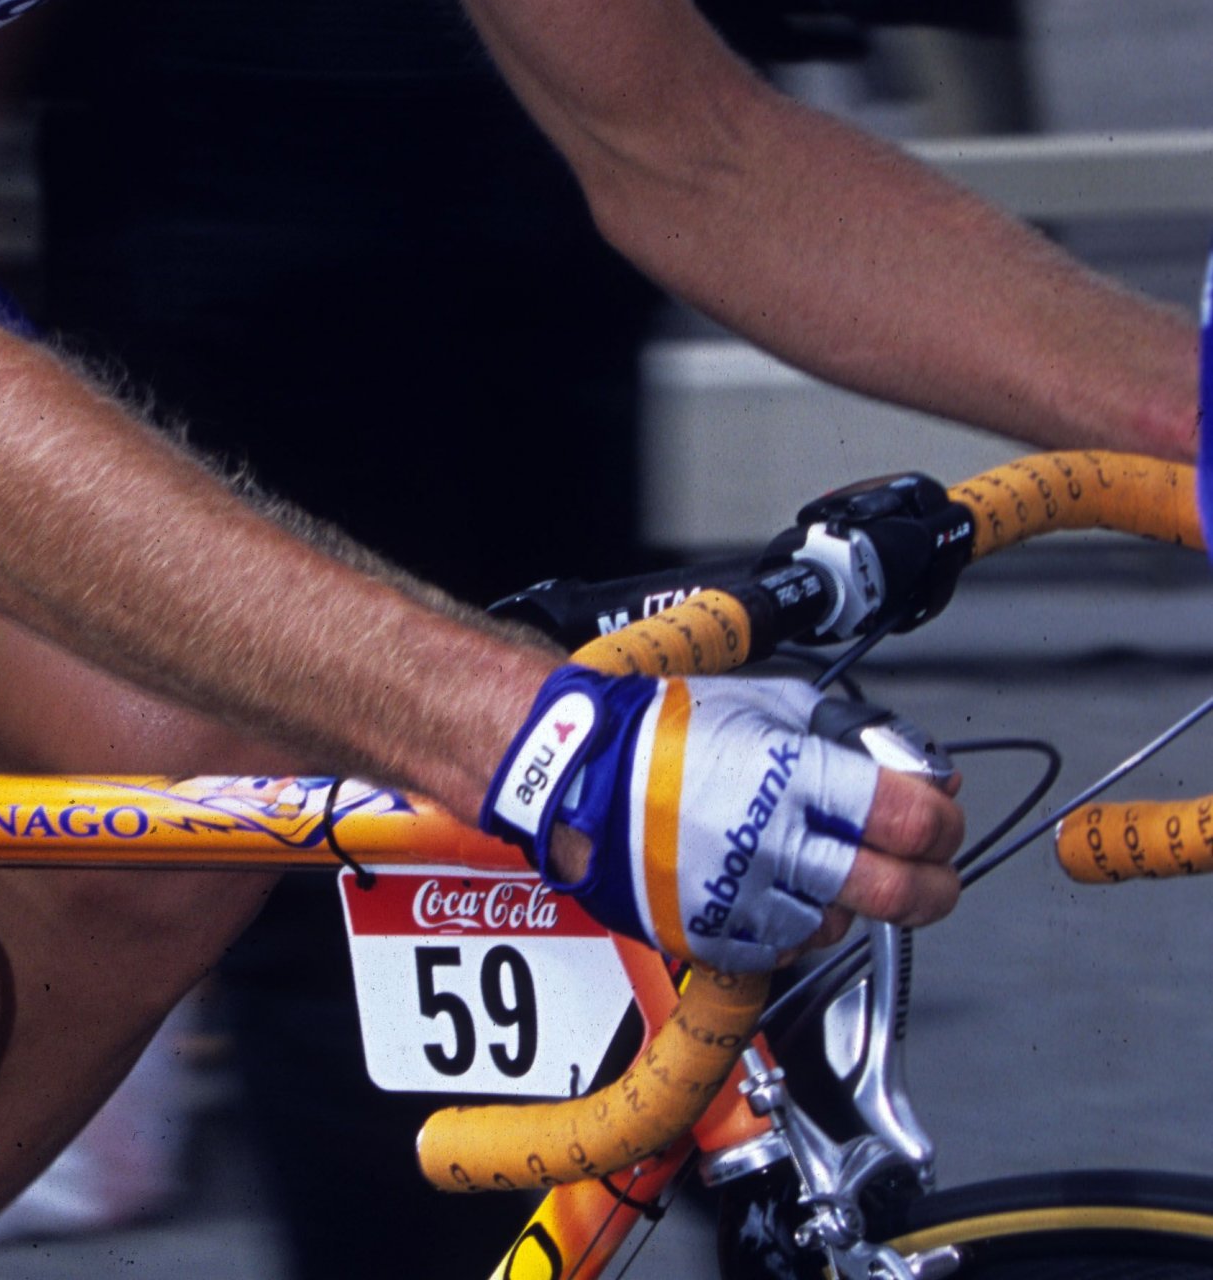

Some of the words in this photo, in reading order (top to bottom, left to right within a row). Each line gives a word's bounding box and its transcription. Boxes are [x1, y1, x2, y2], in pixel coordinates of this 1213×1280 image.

[516, 744, 556, 806] agu
[689, 742, 801, 938] Rabobank
[412, 878, 558, 929] Coca-Cola
[414, 944, 539, 1079] 59
